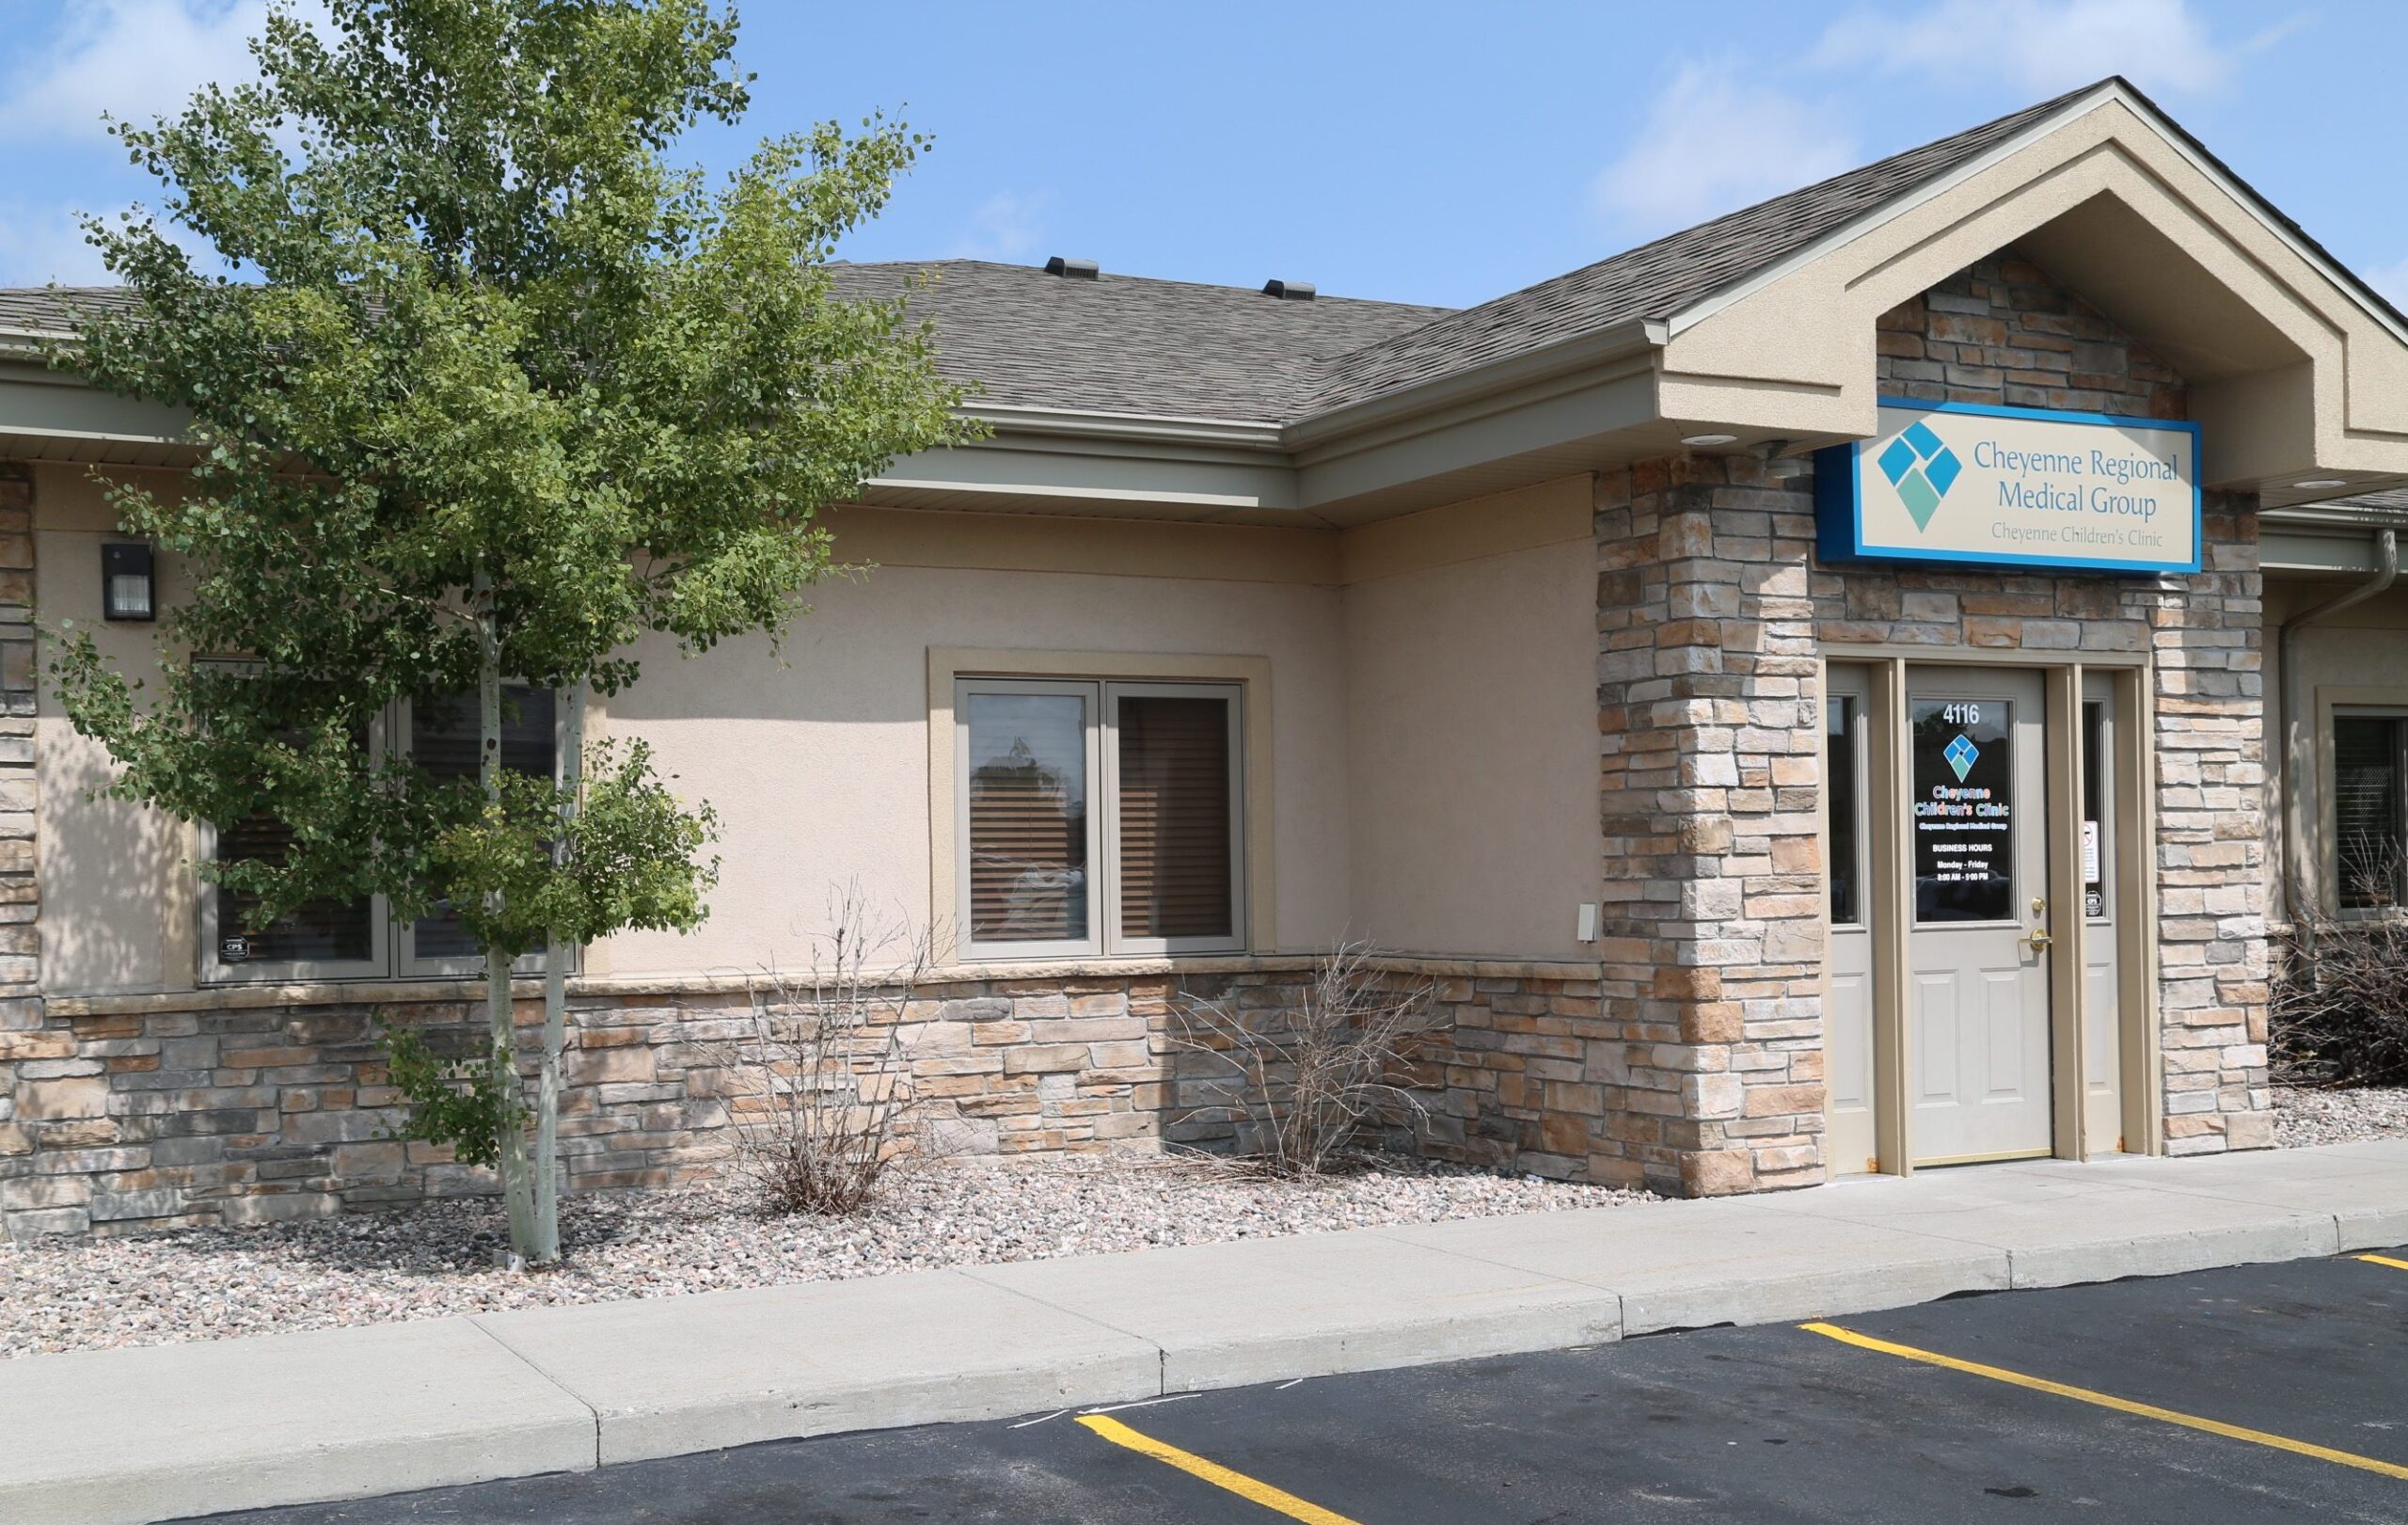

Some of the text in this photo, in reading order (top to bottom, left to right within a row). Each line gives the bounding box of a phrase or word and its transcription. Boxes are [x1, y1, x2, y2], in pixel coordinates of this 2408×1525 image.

[1974, 441, 2178, 485] Cheyenne Regional
[1999, 481, 2156, 523] Medical Group
[1991, 521, 2163, 548] Cheyenne Children's Clinic
[1943, 704, 1980, 724] 4116
[1932, 785, 1991, 802] Cheyenne
[1914, 802, 2010, 817] Children's Clinic
[1932, 844, 1992, 852] BUSINESS HOURS
[1937, 860, 1963, 870] Monday
[1968, 860, 1988, 870] Friday
[1951, 872, 1961, 881] AM
[1978, 872, 1988, 881] PM
